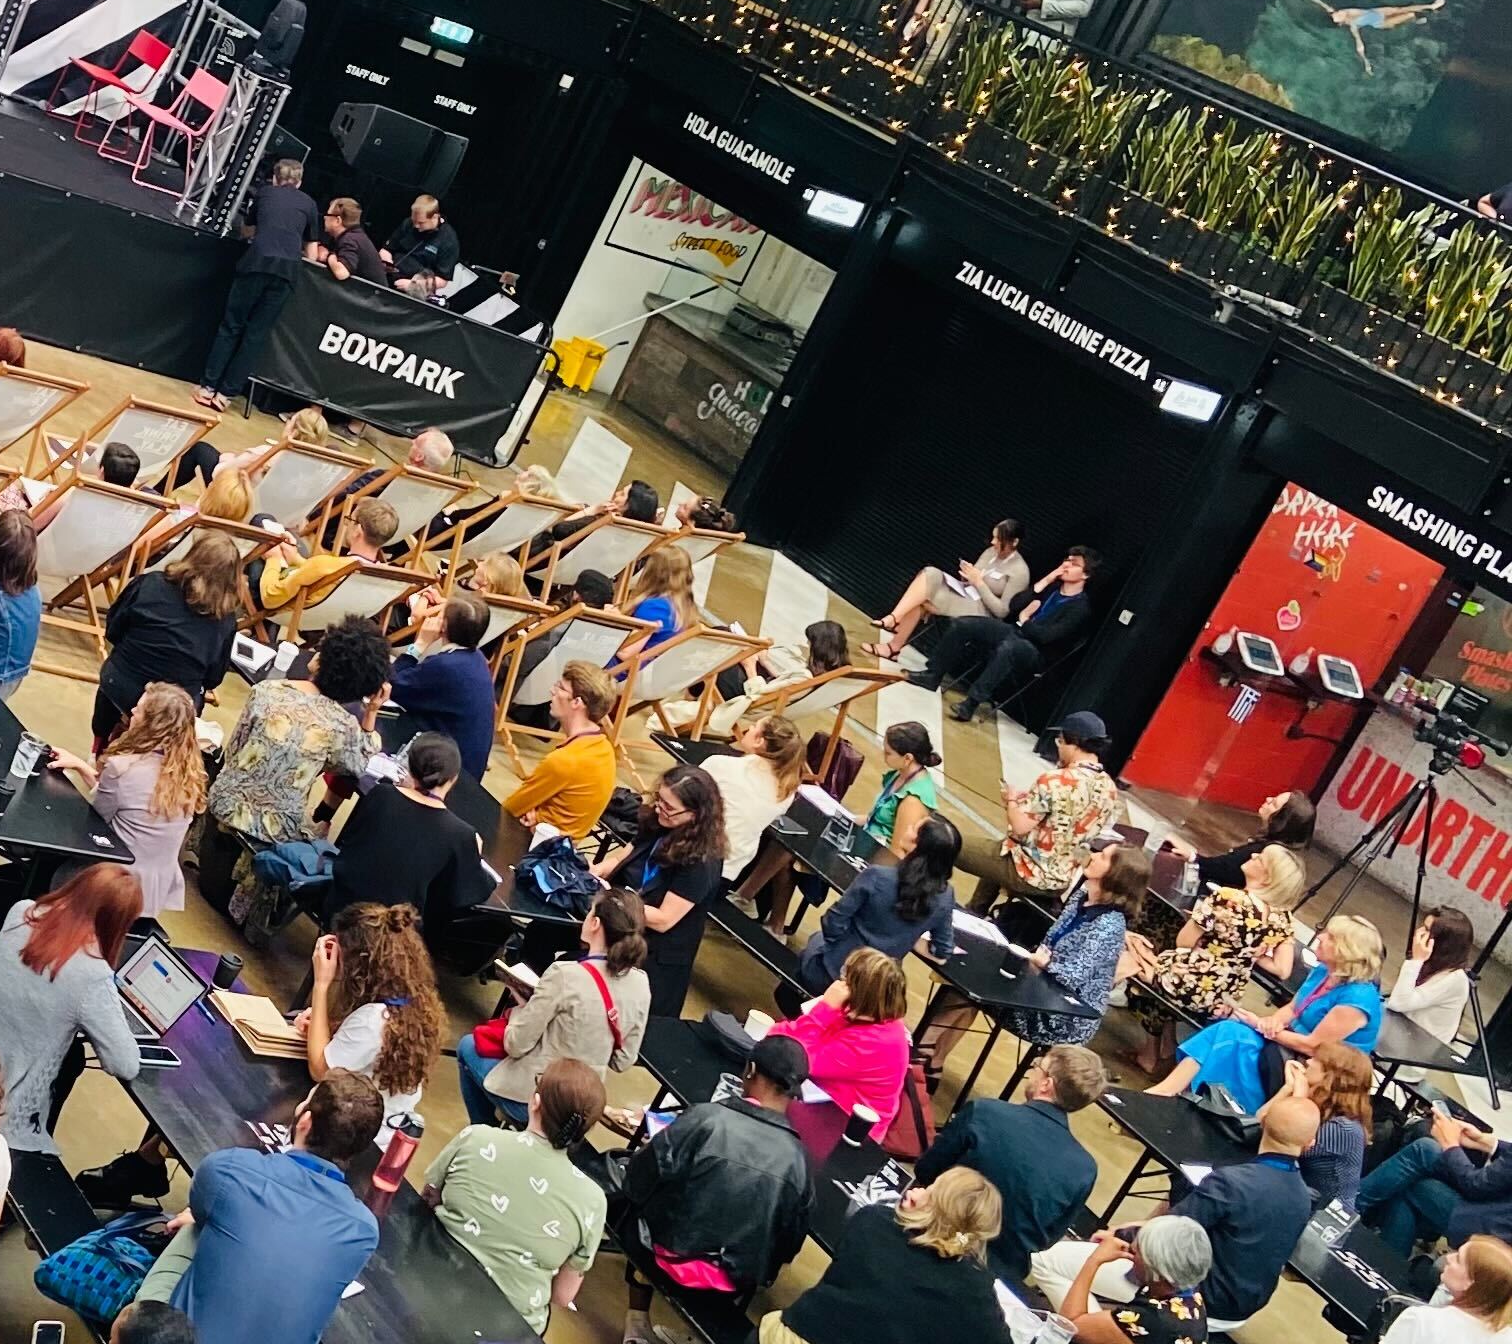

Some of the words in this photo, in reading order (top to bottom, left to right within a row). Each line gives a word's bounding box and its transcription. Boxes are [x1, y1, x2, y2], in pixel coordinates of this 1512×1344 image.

[345, 63, 371, 81] STAFF
[369, 71, 390, 86] ONLY
[434, 94, 458, 111] STAFF
[456, 101, 477, 116] ONLY
[683, 111, 717, 144] HOLA
[716, 131, 795, 184] GUACAMOLE
[955, 261, 984, 291] ZIA
[982, 274, 1030, 316] LUCIA
[1028, 300, 1104, 354] GENUINE
[1098, 338, 1150, 381] PIZZA
[319, 323, 465, 399] BOXPARK
[1367, 486, 1477, 558] SMASHING
